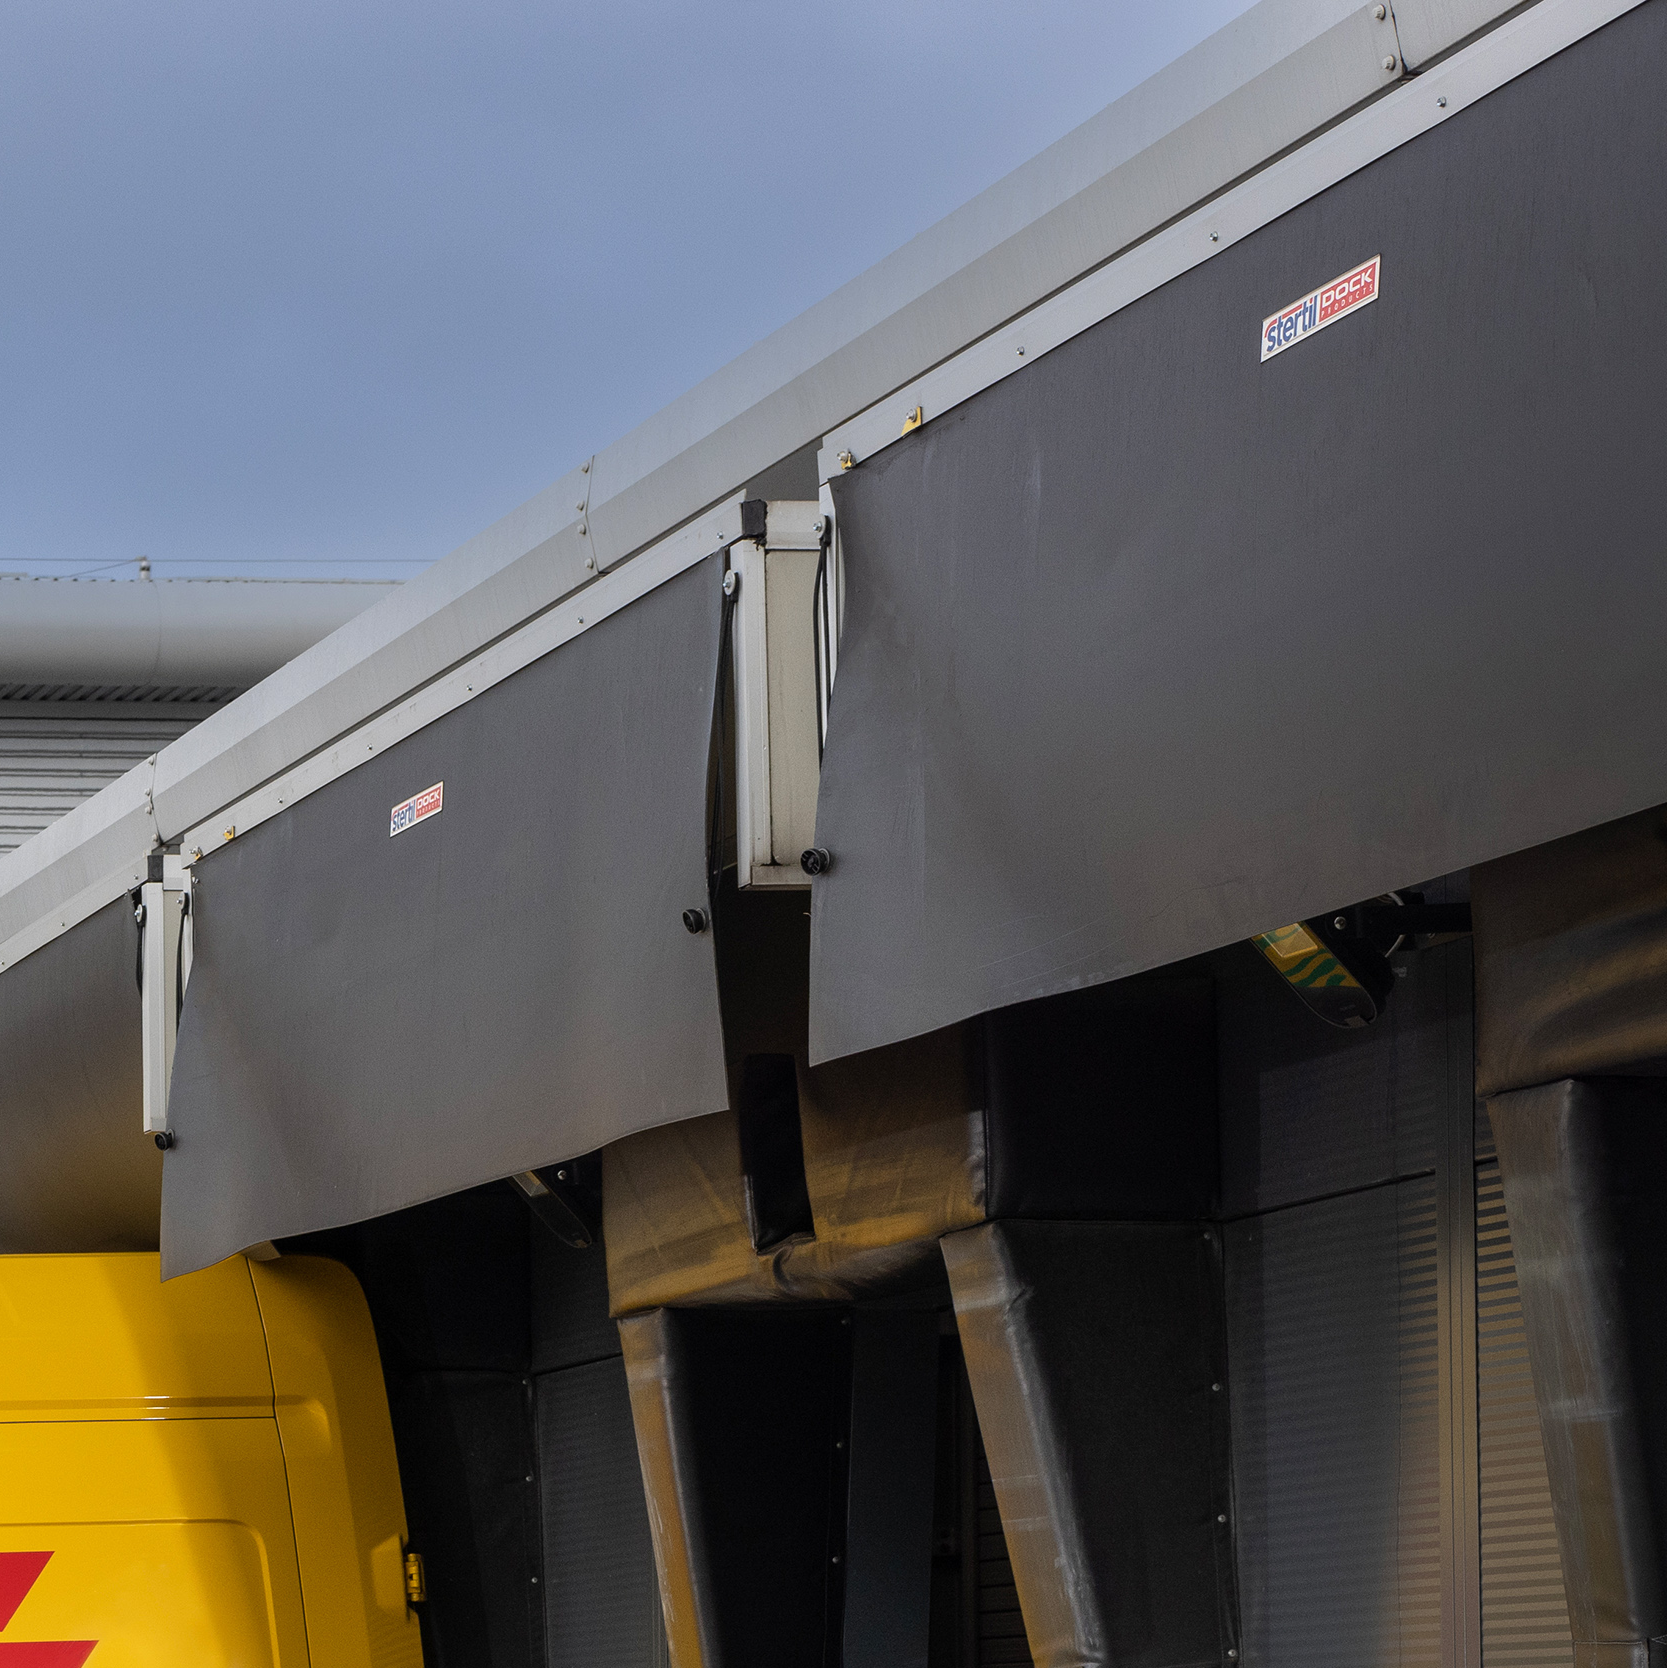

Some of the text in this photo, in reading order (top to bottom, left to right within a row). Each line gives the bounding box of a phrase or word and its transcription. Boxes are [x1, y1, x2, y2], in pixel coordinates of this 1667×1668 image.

[1320, 284, 1373, 318] PRODUCTS
[1322, 267, 1373, 308] DOCK
[1266, 293, 1319, 352] stertil
[417, 789, 440, 809] DOCK
